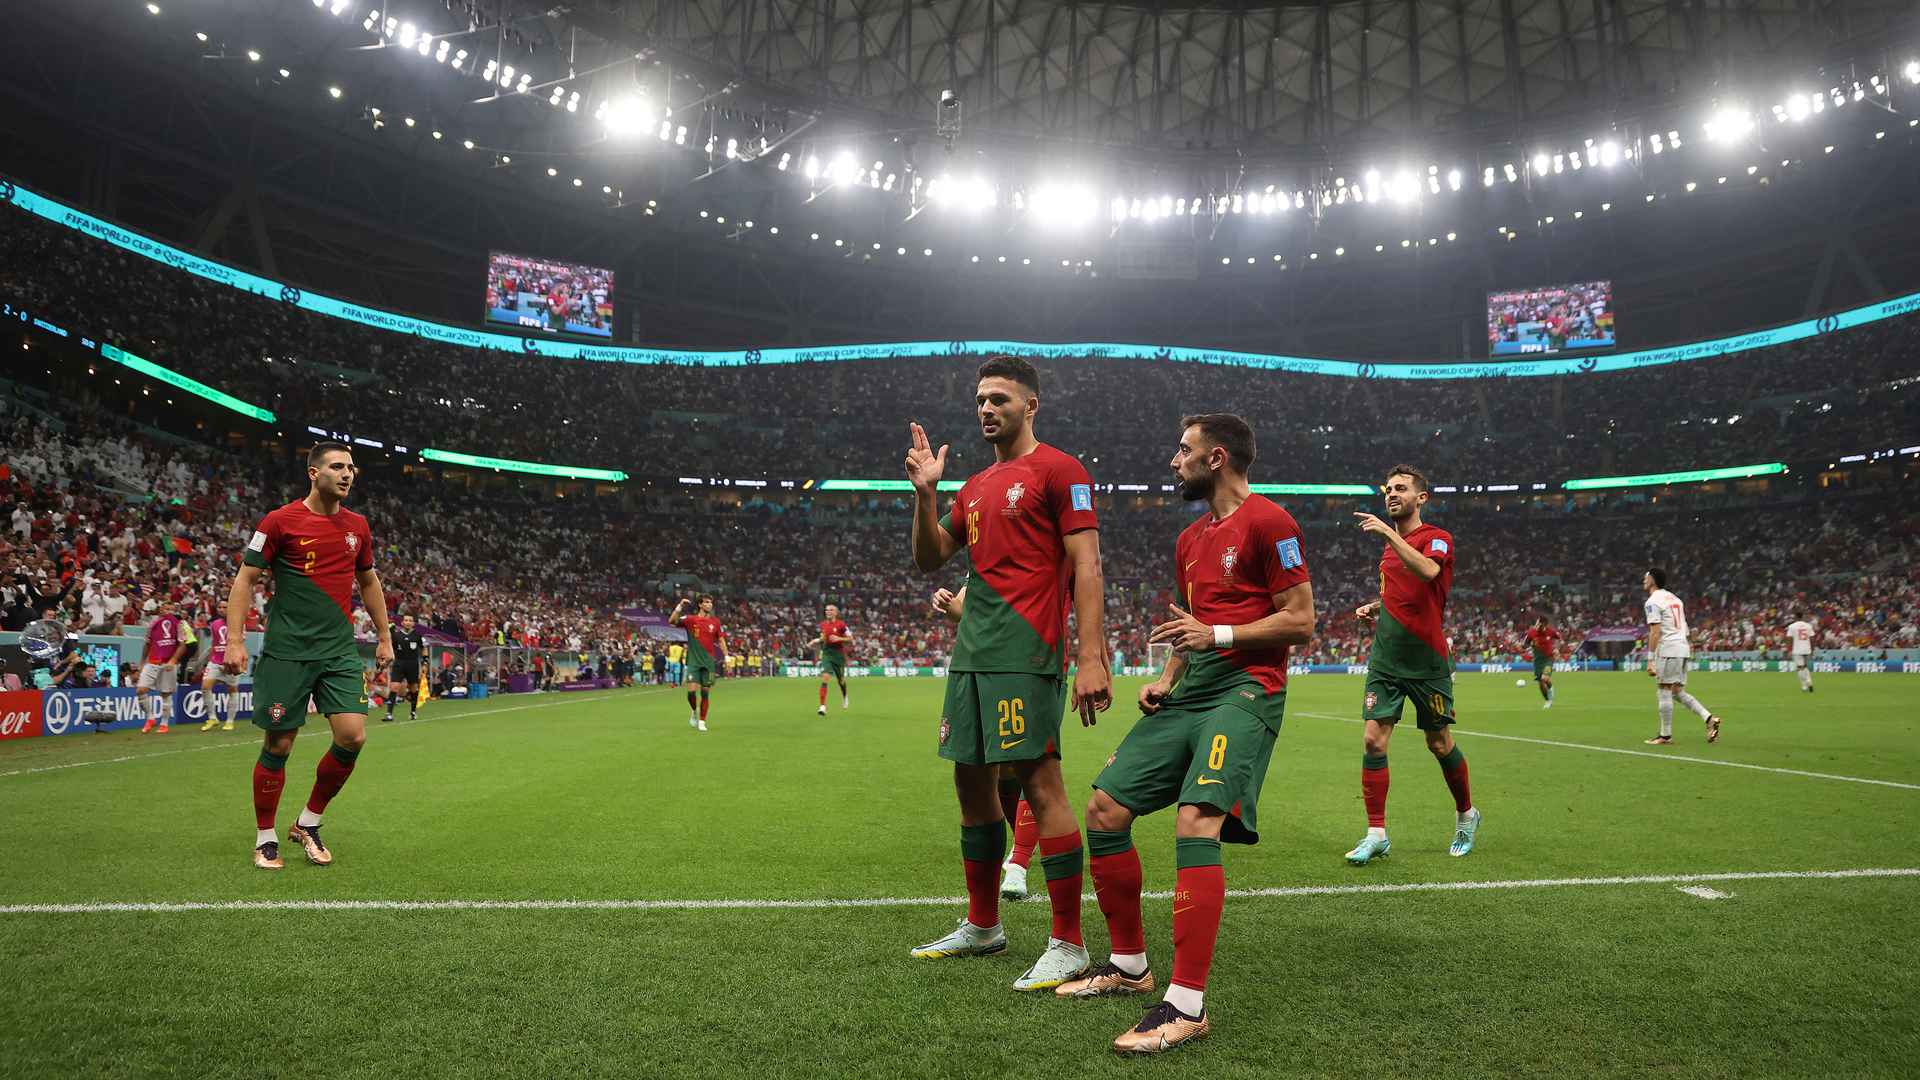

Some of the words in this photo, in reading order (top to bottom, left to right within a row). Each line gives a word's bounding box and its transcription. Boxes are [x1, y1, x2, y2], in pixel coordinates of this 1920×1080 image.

[65, 212, 90, 228] FIFA
[91, 222, 130, 244] WORLD
[132, 238, 153, 251] CUP
[342, 306, 362, 318] FIFA
[363, 311, 396, 326] WORLD
[304, 551, 316, 575] 2
[1481, 663, 1512, 673] FIFA+
[115, 695, 175, 721] WAD
[997, 698, 1025, 737] 26
[0, 711, 32, 735] er
[1208, 734, 1228, 771] 8
